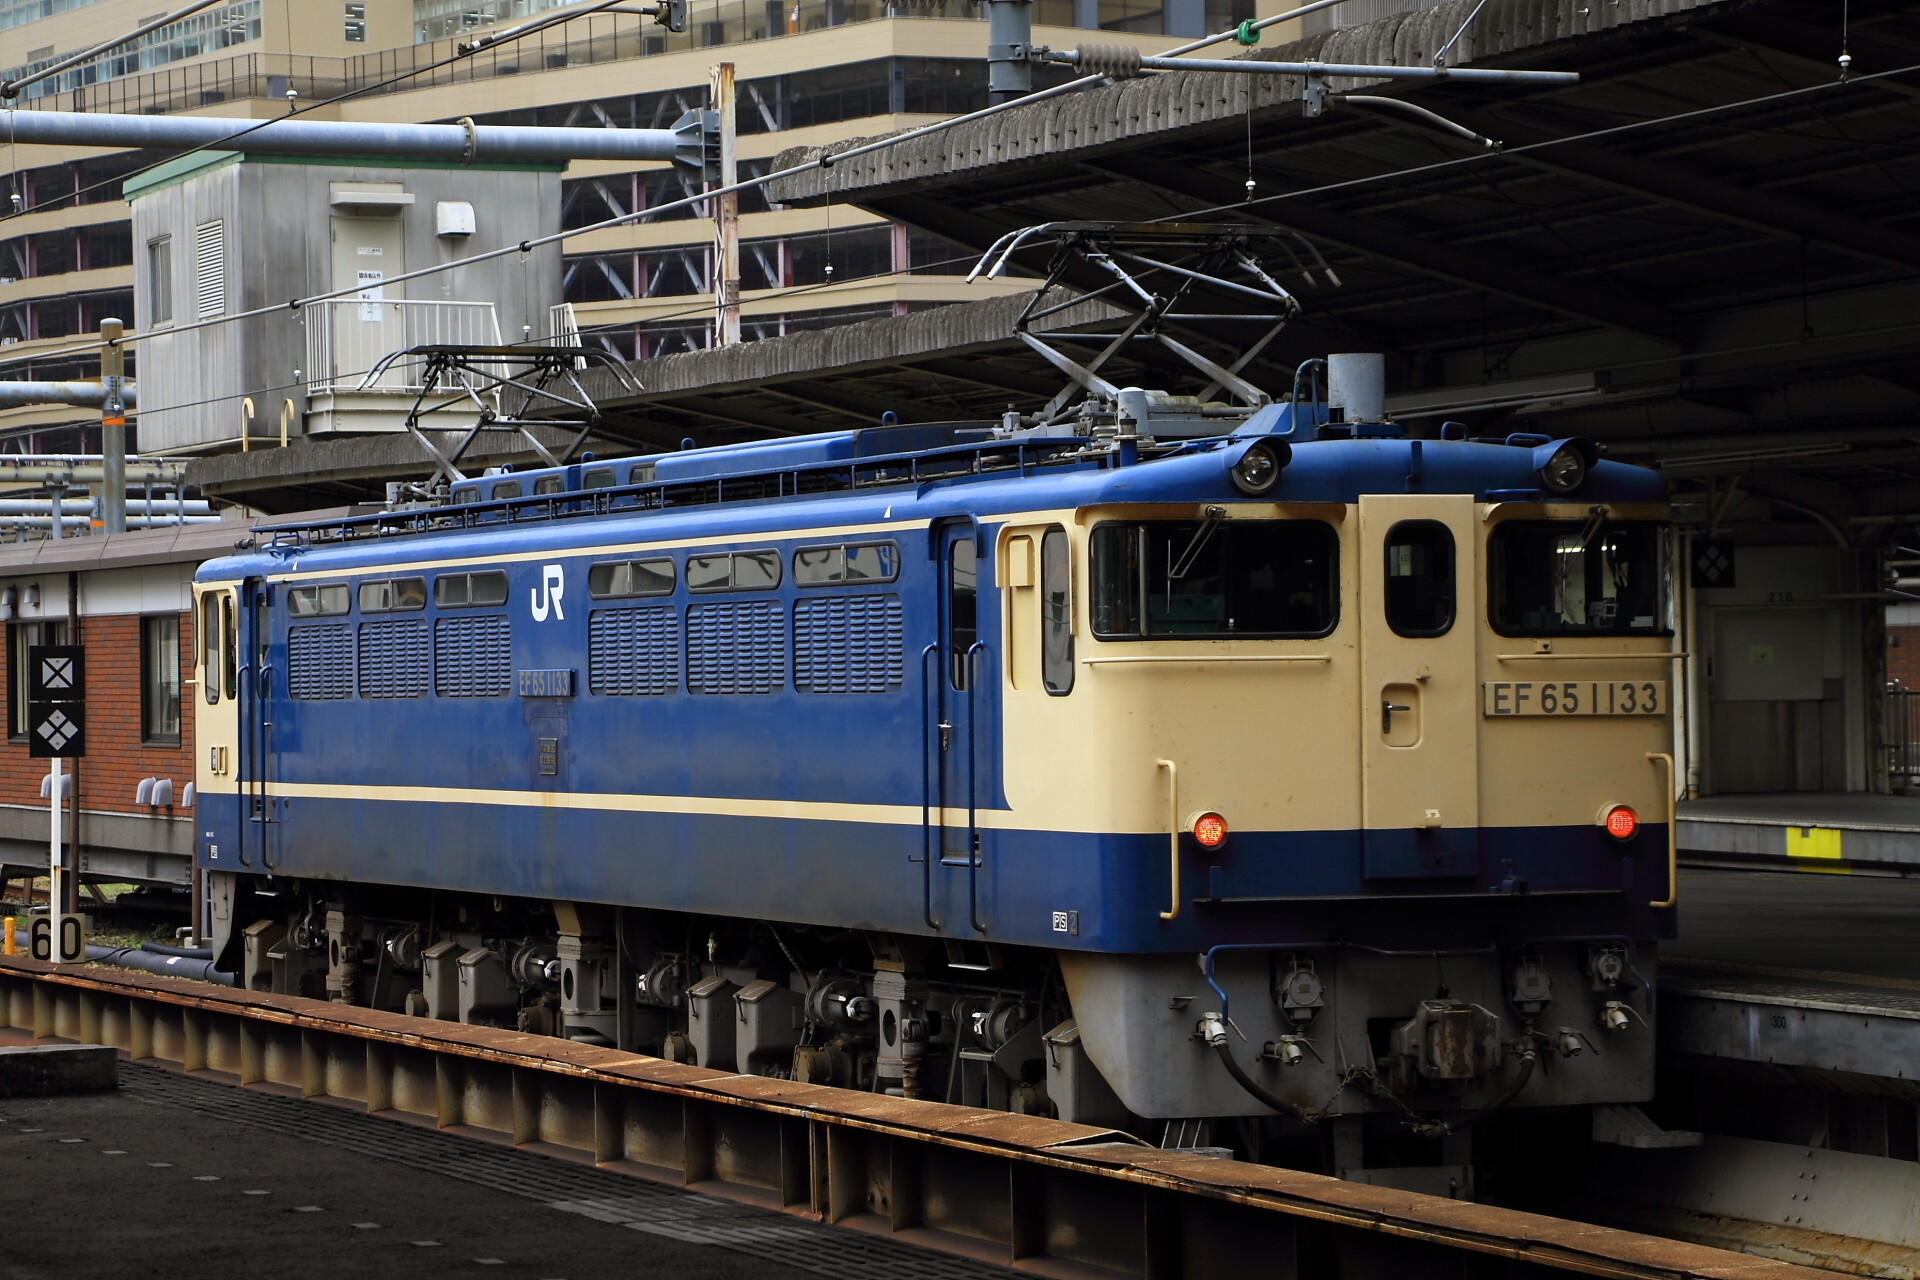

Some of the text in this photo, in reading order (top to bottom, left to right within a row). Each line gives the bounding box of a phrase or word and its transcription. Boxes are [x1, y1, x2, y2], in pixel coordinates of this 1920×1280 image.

[531, 564, 565, 622] JR
[547, 671, 568, 696] 1133
[1592, 683, 1658, 714] 1133
[1053, 912, 1067, 931] PS
[32, 917, 81, 960] 60
